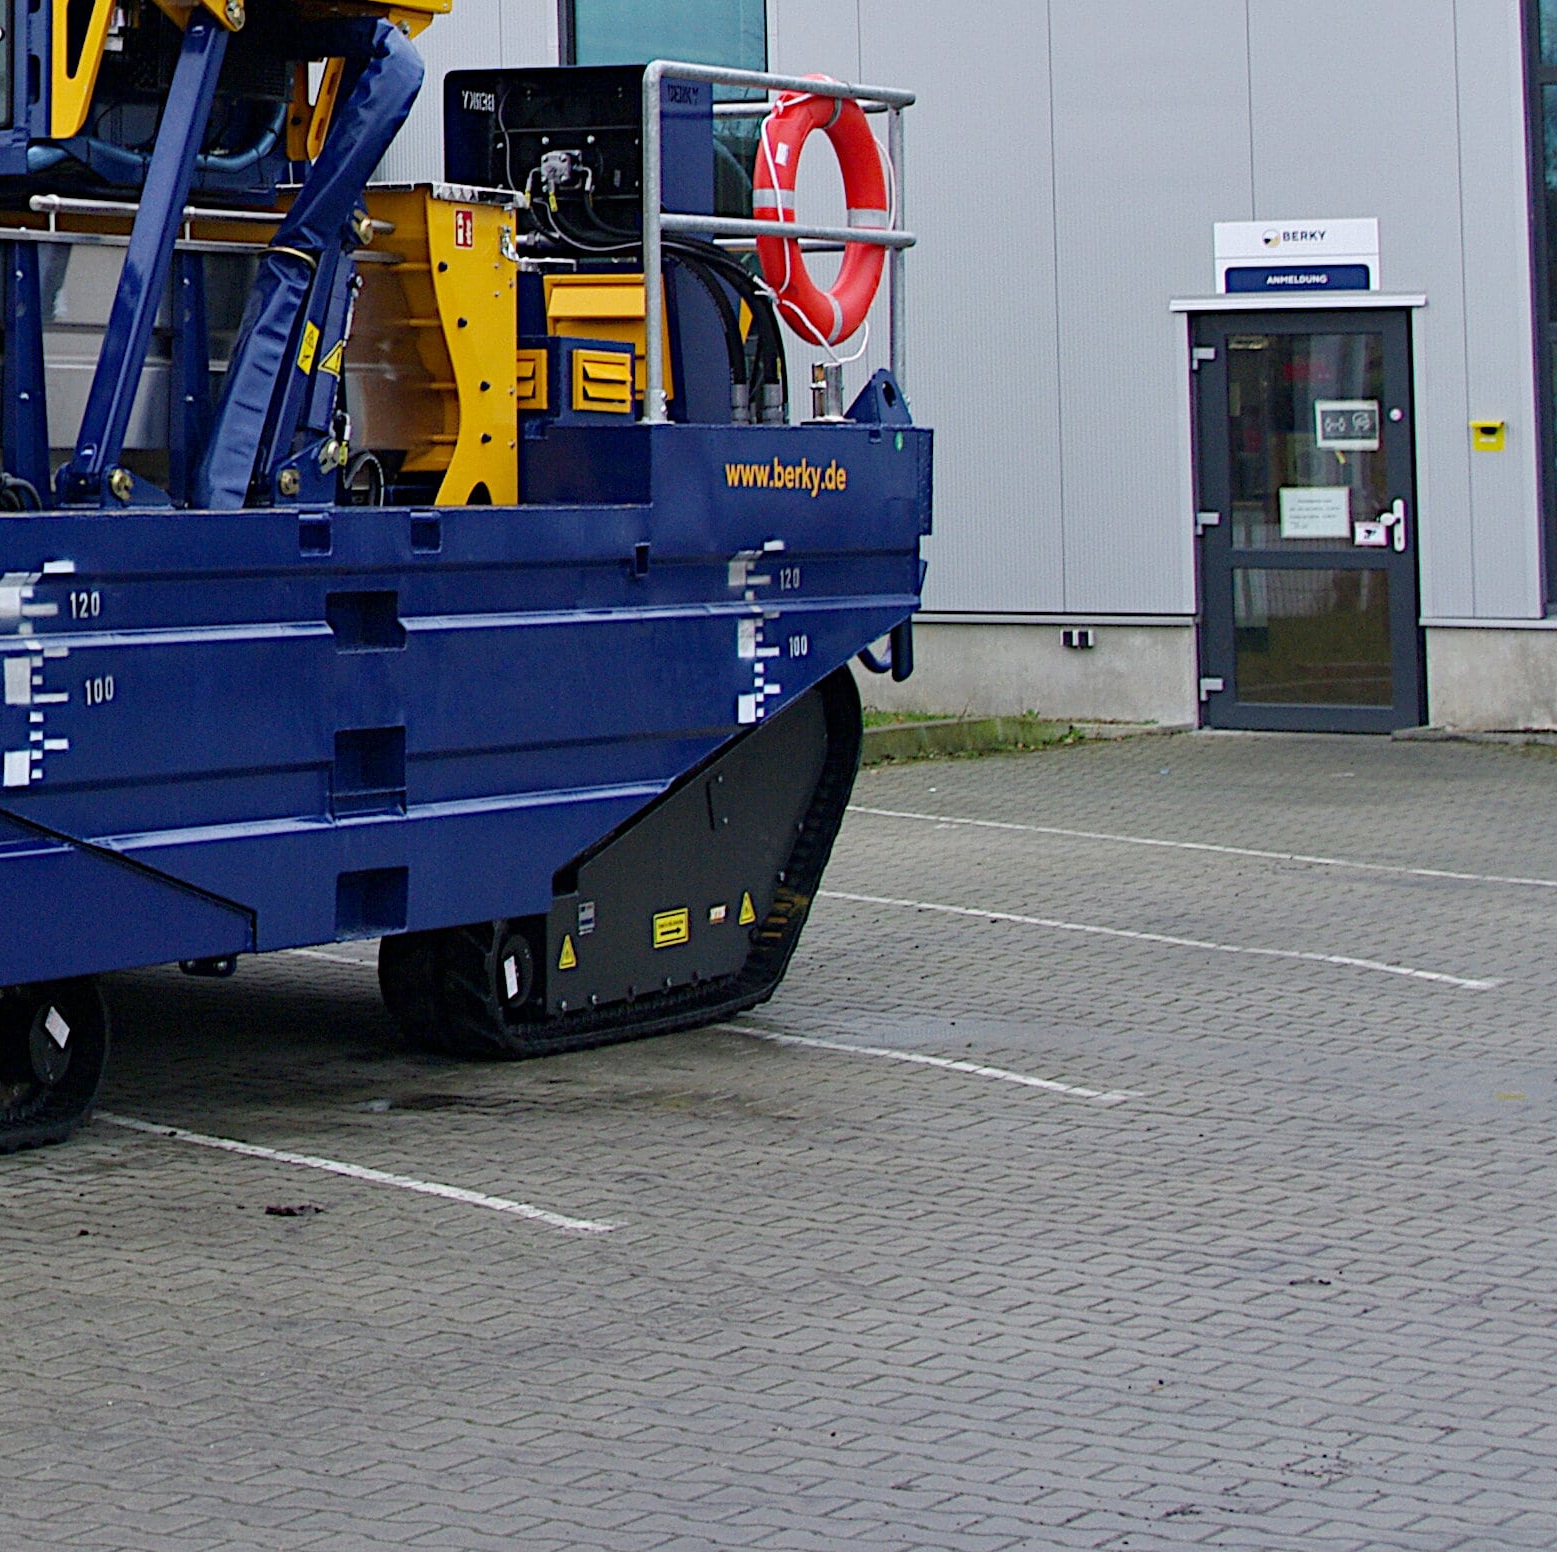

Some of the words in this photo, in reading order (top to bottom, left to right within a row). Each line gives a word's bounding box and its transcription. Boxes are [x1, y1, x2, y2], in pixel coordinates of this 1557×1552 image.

[1282, 230, 1326, 241] BERKY
[1266, 274, 1328, 285] ANMELDUNG
[725, 456, 847, 498] www.berky.de
[780, 567, 801, 590] 120
[70, 590, 101, 619] 120
[789, 635, 808, 659] 100
[85, 675, 114, 706] 100
